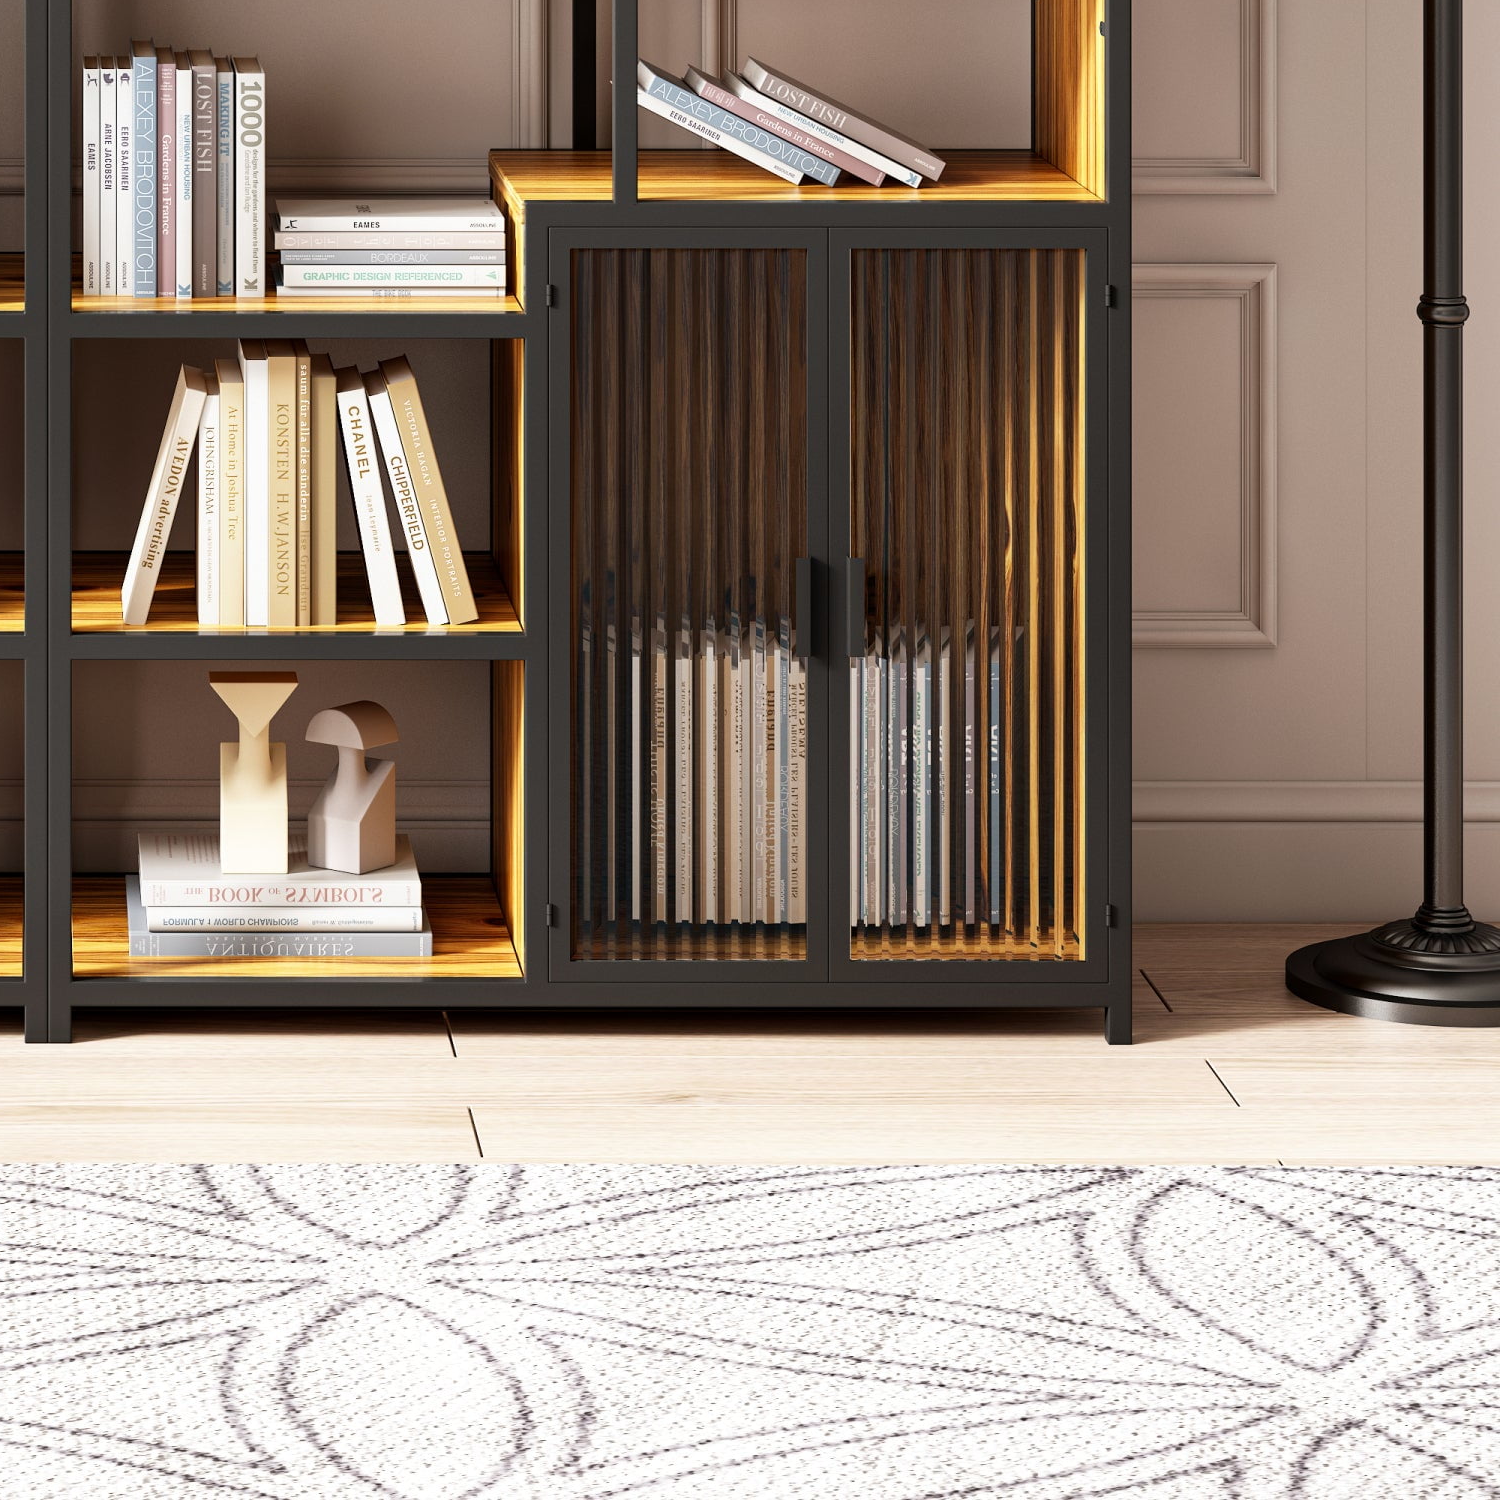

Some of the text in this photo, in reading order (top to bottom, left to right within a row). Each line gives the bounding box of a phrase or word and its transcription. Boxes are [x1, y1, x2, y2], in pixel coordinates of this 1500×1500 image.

[240, 80, 263, 148] 1000
[652, 82, 828, 182] ALEXEY BRODOVITCH
[755, 113, 835, 160] Gardens in France
[766, 80, 848, 130] LOST FISH
[88, 143, 96, 172] EAMES
[104, 123, 112, 191] ARNE JACOBSEN
[121, 126, 129, 192] EERO SAARINEN
[353, 221, 380, 229] EAMES
[348, 404, 371, 479] CHANEL
[140, 436, 190, 570] AVEDON advertising
[276, 403, 290, 596] KONSTEN H.W.JANSON
[390, 456, 424, 551] CHIPPERFIELD
